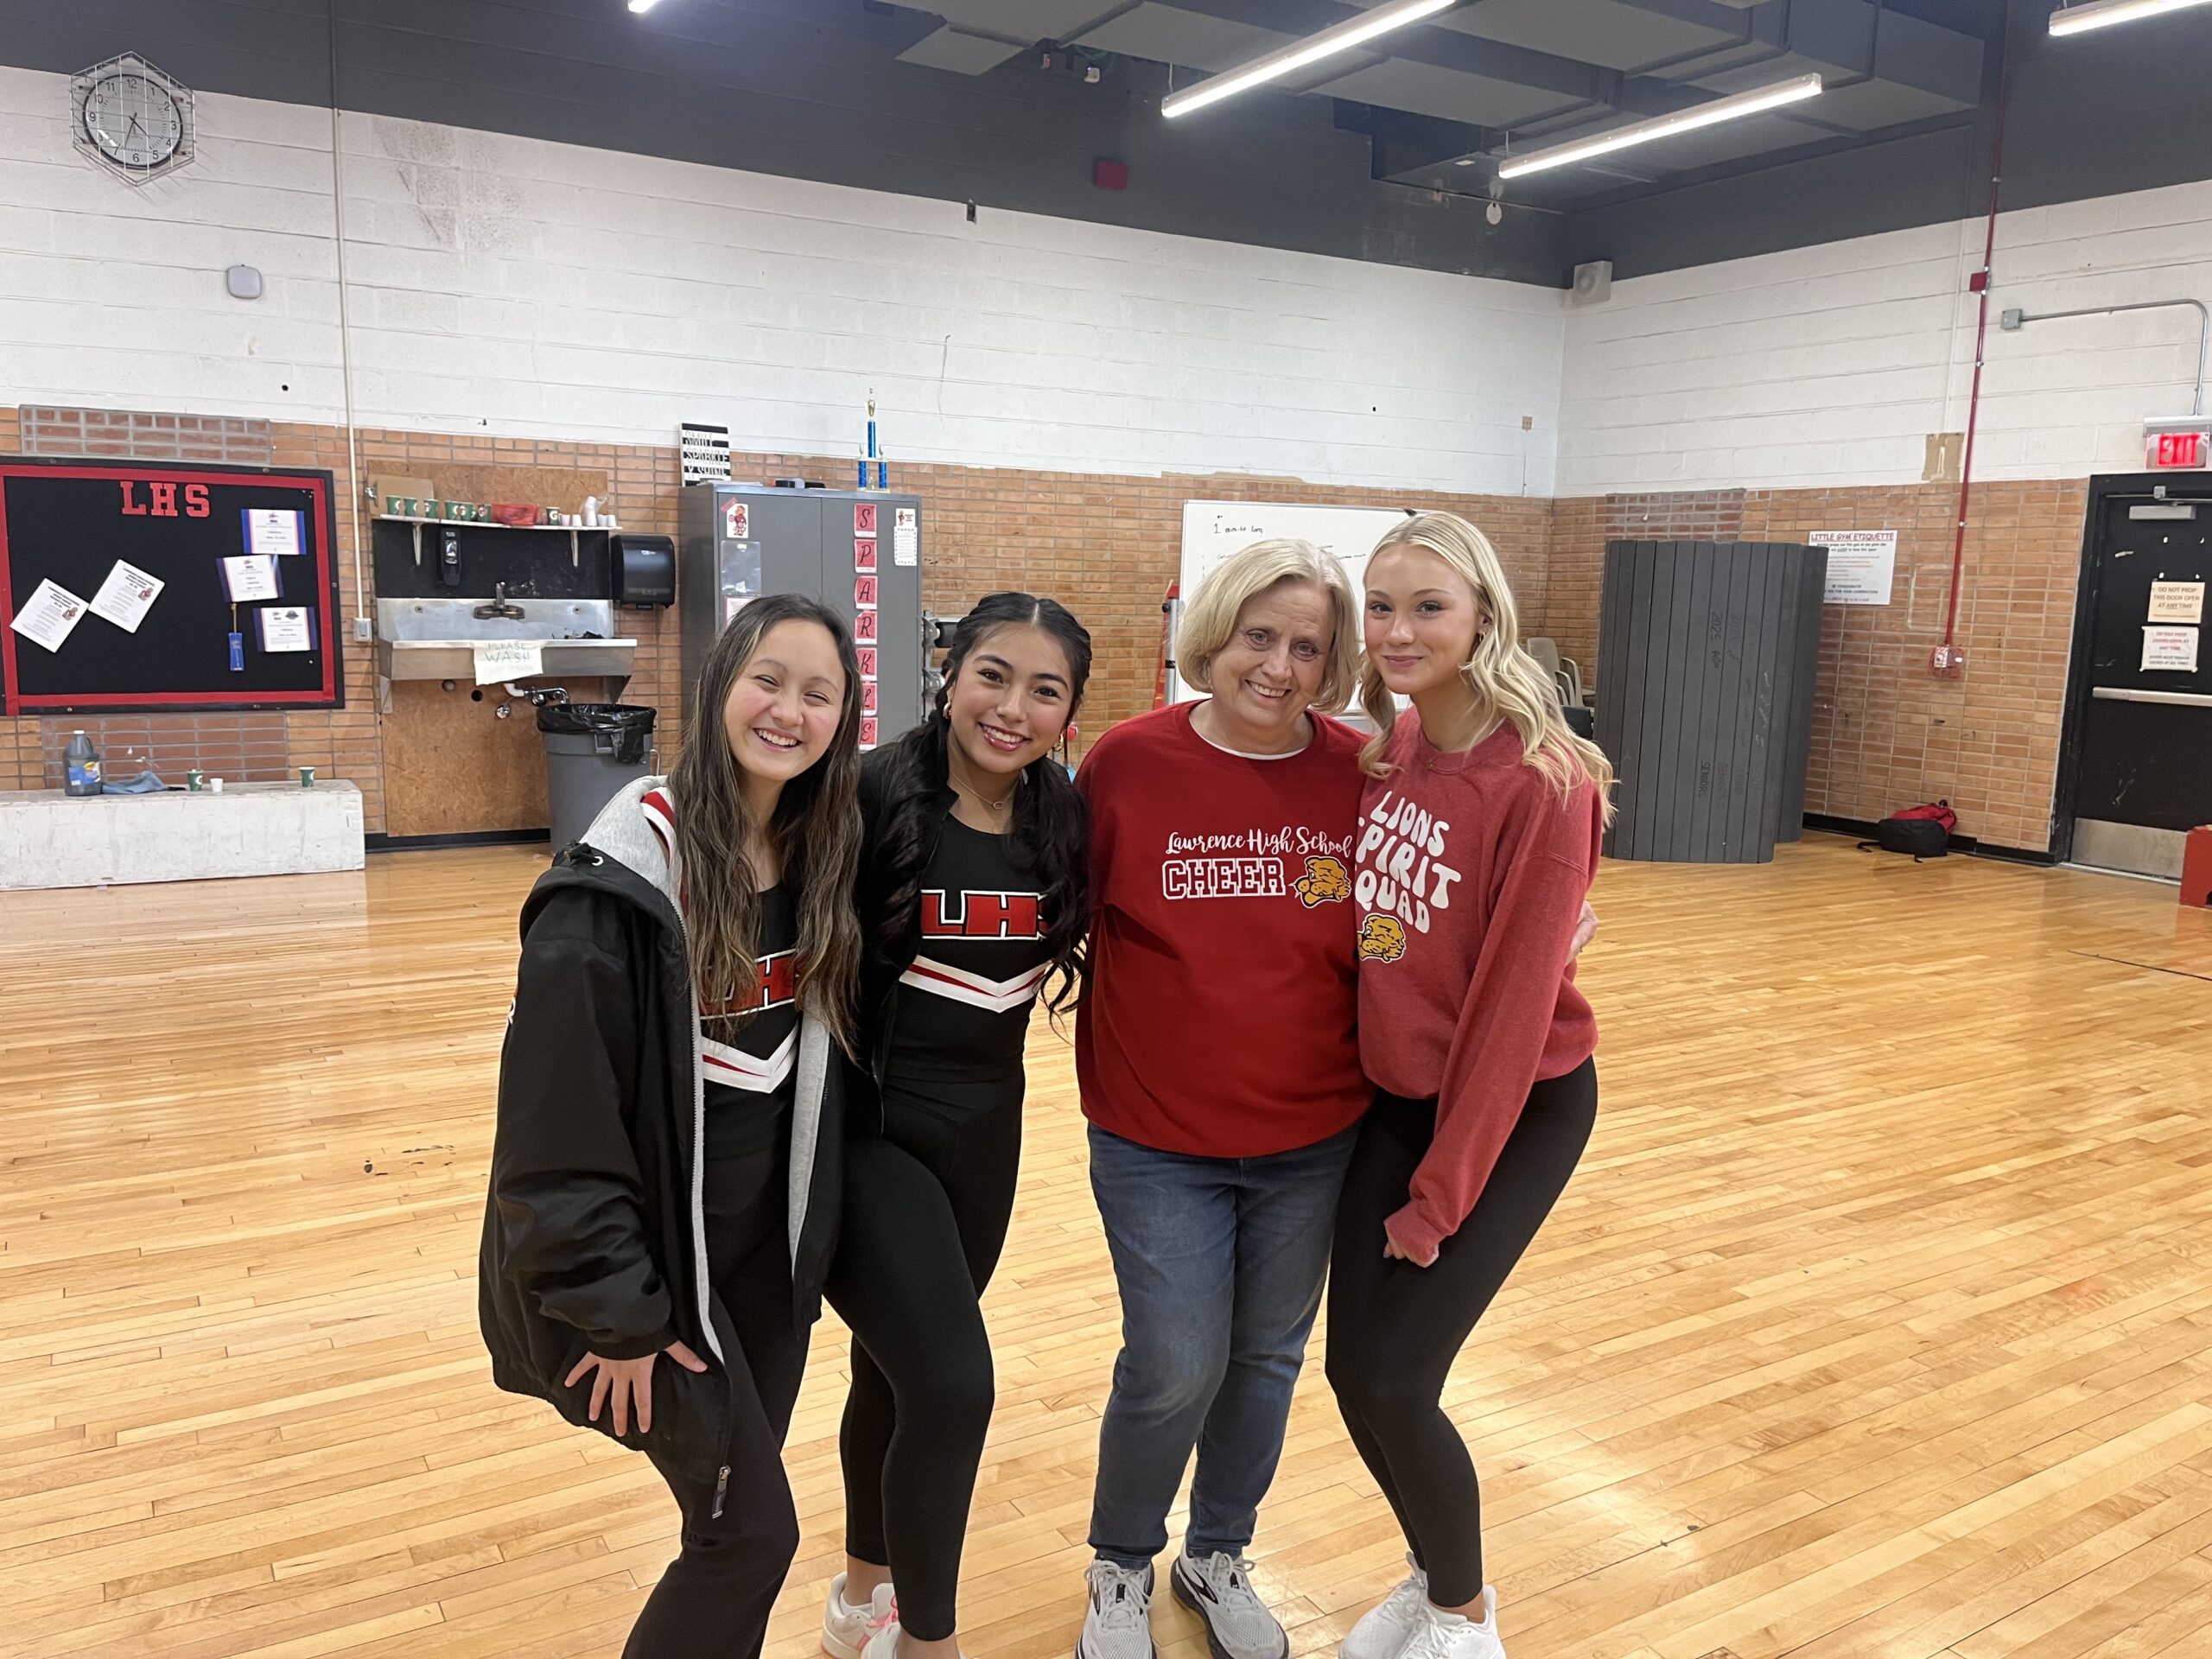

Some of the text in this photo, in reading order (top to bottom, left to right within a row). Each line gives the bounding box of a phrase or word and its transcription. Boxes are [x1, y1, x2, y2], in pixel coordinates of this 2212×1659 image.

[105, 82, 116, 92] 11
[126, 79, 137, 89] 12
[150, 87, 156, 96] 1
[94, 93, 104, 104] 10
[163, 101, 171, 111] 2
[89, 111, 96, 122] 9
[170, 120, 177, 130] 3
[165, 138, 172, 147] 4
[111, 146, 119, 156] 7
[152, 149, 159, 160] 5
[132, 153, 140, 162] 6
[2158, 434, 2201, 465] EXIT
[120, 480, 210, 518] LHS
[550, 510, 558, 520] G
[1811, 533, 1834, 542] LITTLE
[1853, 532, 1895, 541] ETIQUETTE
[1711, 611, 1724, 640] 2025
[484, 651, 531, 664] WASH
[1698, 760, 1711, 798] SENIORS
[1370, 791, 1450, 857] LIONS
[1166, 826, 1353, 858] Lawrence High School
[1355, 817, 1462, 909] PIRIT
[1162, 857, 1286, 899] CHEER
[1355, 869, 1430, 933] QUAD
[920, 889, 1048, 940] LH
